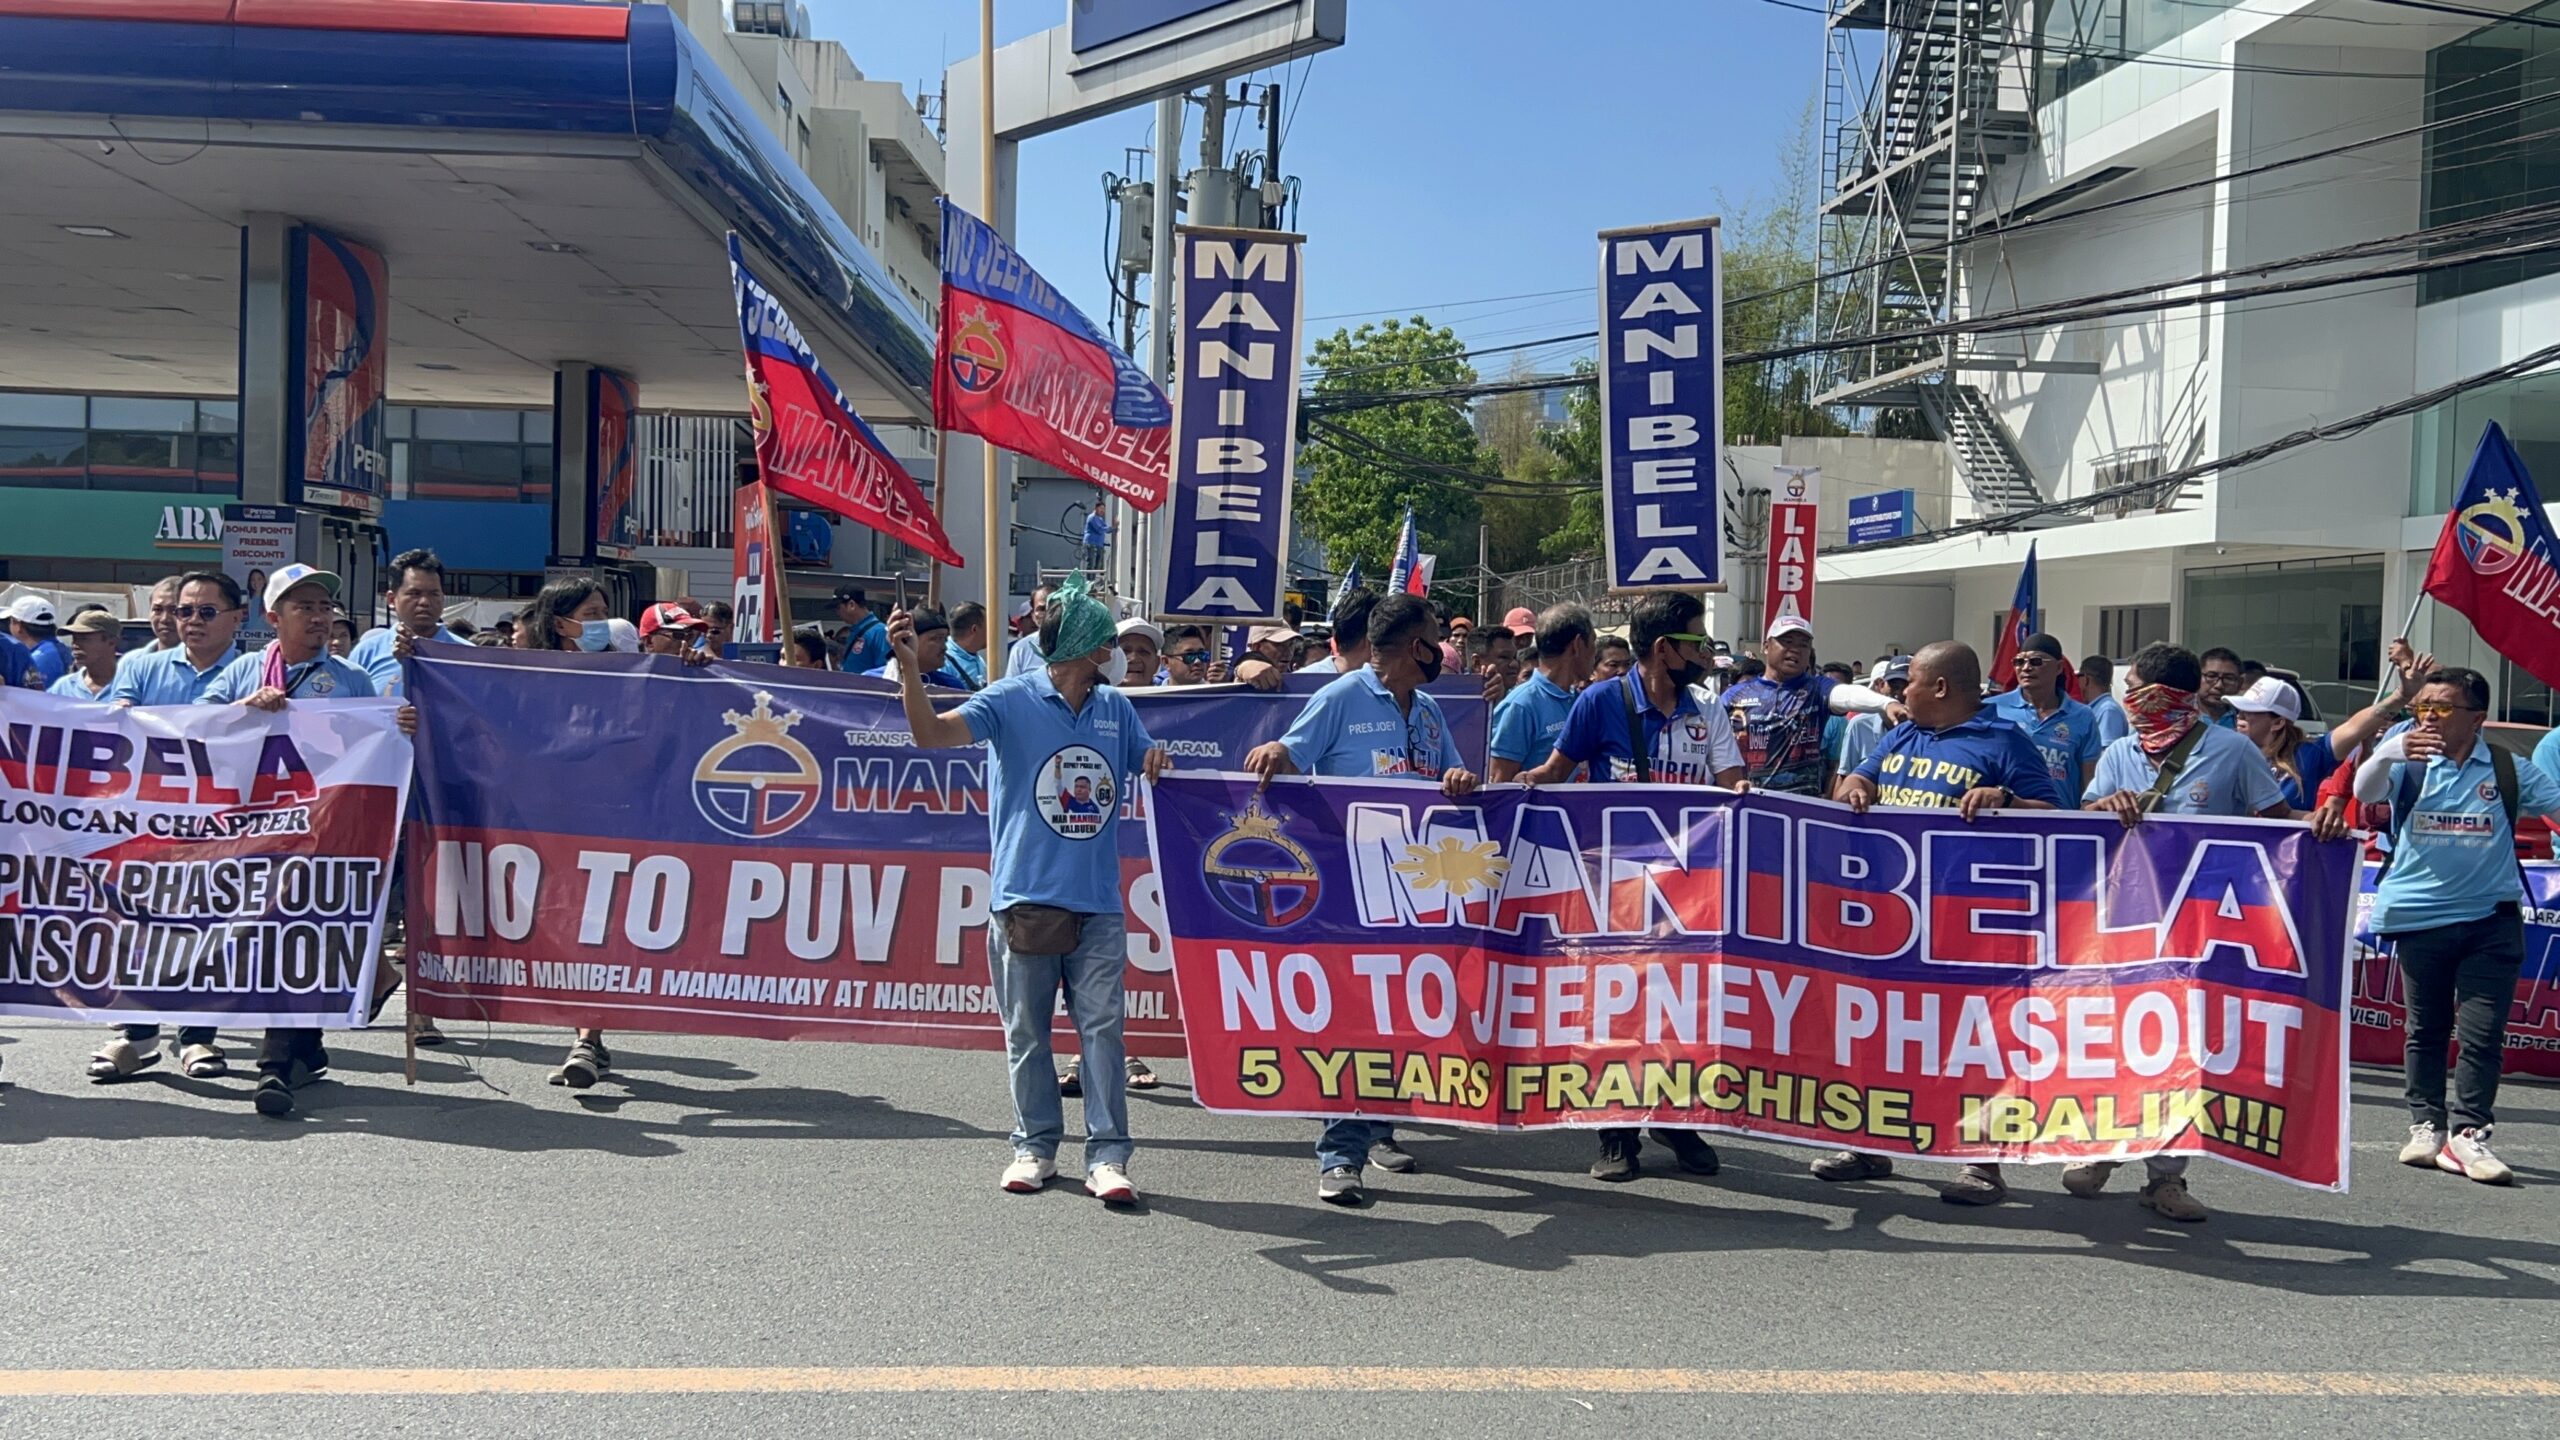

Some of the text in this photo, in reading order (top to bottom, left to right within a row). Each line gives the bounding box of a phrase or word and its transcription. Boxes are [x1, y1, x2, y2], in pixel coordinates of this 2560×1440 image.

[1177, 241, 1282, 611] MANIBELA
[1616, 234, 1706, 581] MANIBELA
[226, 525, 293, 535] BONUS POINTS
[232, 549, 286, 559] DISCOUNTS
[1881, 753, 1982, 789] NO TO PUV
[147, 805, 310, 839] CHAPTER
[119, 858, 271, 918] PHASE
[276, 856, 381, 917] OUT
[434, 840, 541, 942] NO
[577, 849, 691, 952] TO
[719, 859, 905, 963] PUV
[1346, 801, 2309, 979] MANIBELA
[0, 914, 372, 993] NSOLIDATION
[417, 951, 527, 987] SAMAHANG
[531, 961, 652, 994] MANIBELA
[660, 970, 827, 1006] MANANAKAY
[834, 980, 867, 1008] AT
[873, 981, 1000, 1014] NAGKAISA
[1215, 948, 2302, 1089] NO TO JEEPNEY PHASEOUT
[1238, 1047, 2287, 1159] 5 YEARS FRANCHISE, IBALIK!!!
